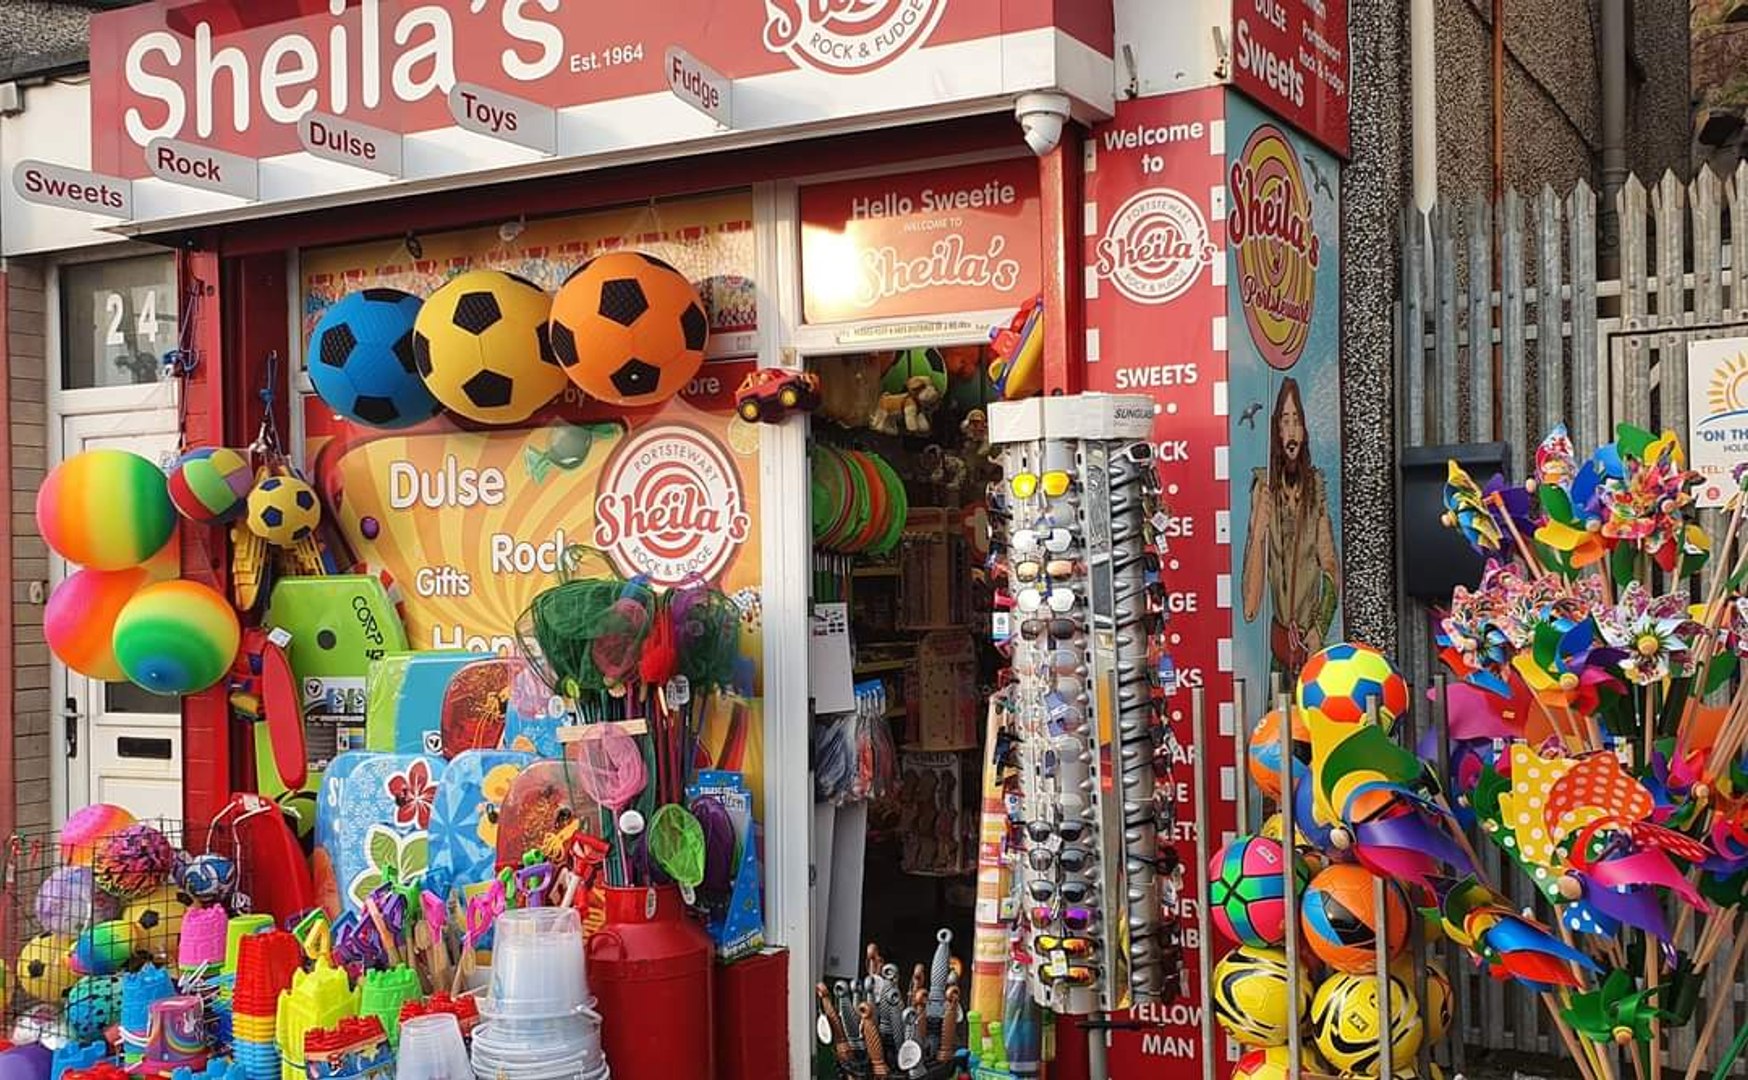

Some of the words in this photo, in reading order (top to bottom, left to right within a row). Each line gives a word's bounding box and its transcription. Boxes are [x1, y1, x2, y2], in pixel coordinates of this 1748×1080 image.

[810, 32, 854, 60] ROCK
[857, 41, 871, 59] &
[873, 0, 925, 52] FUDGE
[671, 55, 720, 109] Fudge
[1237, 18, 1305, 109] Sweets
[460, 91, 519, 133] Toys
[309, 121, 377, 161] Dulse
[1103, 121, 1205, 152] Welcome
[156, 147, 222, 183] Rock
[1141, 153, 1166, 175] to
[24, 169, 124, 208] Sweets
[853, 191, 913, 219] Hello
[920, 180, 1016, 213] Sweetie
[949, 217, 963, 228] TO
[1229, 160, 1320, 270] Sheila's
[852, 233, 1020, 307] Sheila's
[1095, 228, 1217, 279] Sheila's
[685, 376, 721, 396] ore
[1115, 362, 1198, 390] SWEETS
[389, 453, 507, 510] Dulse
[633, 443, 720, 482] PORTSTEWART
[594, 485, 750, 548] Sheila's
[491, 528, 578, 574] Rock
[632, 545, 662, 575] ROCK
[415, 566, 472, 598] Gifts
[1141, 1033, 1195, 1059] MAN
